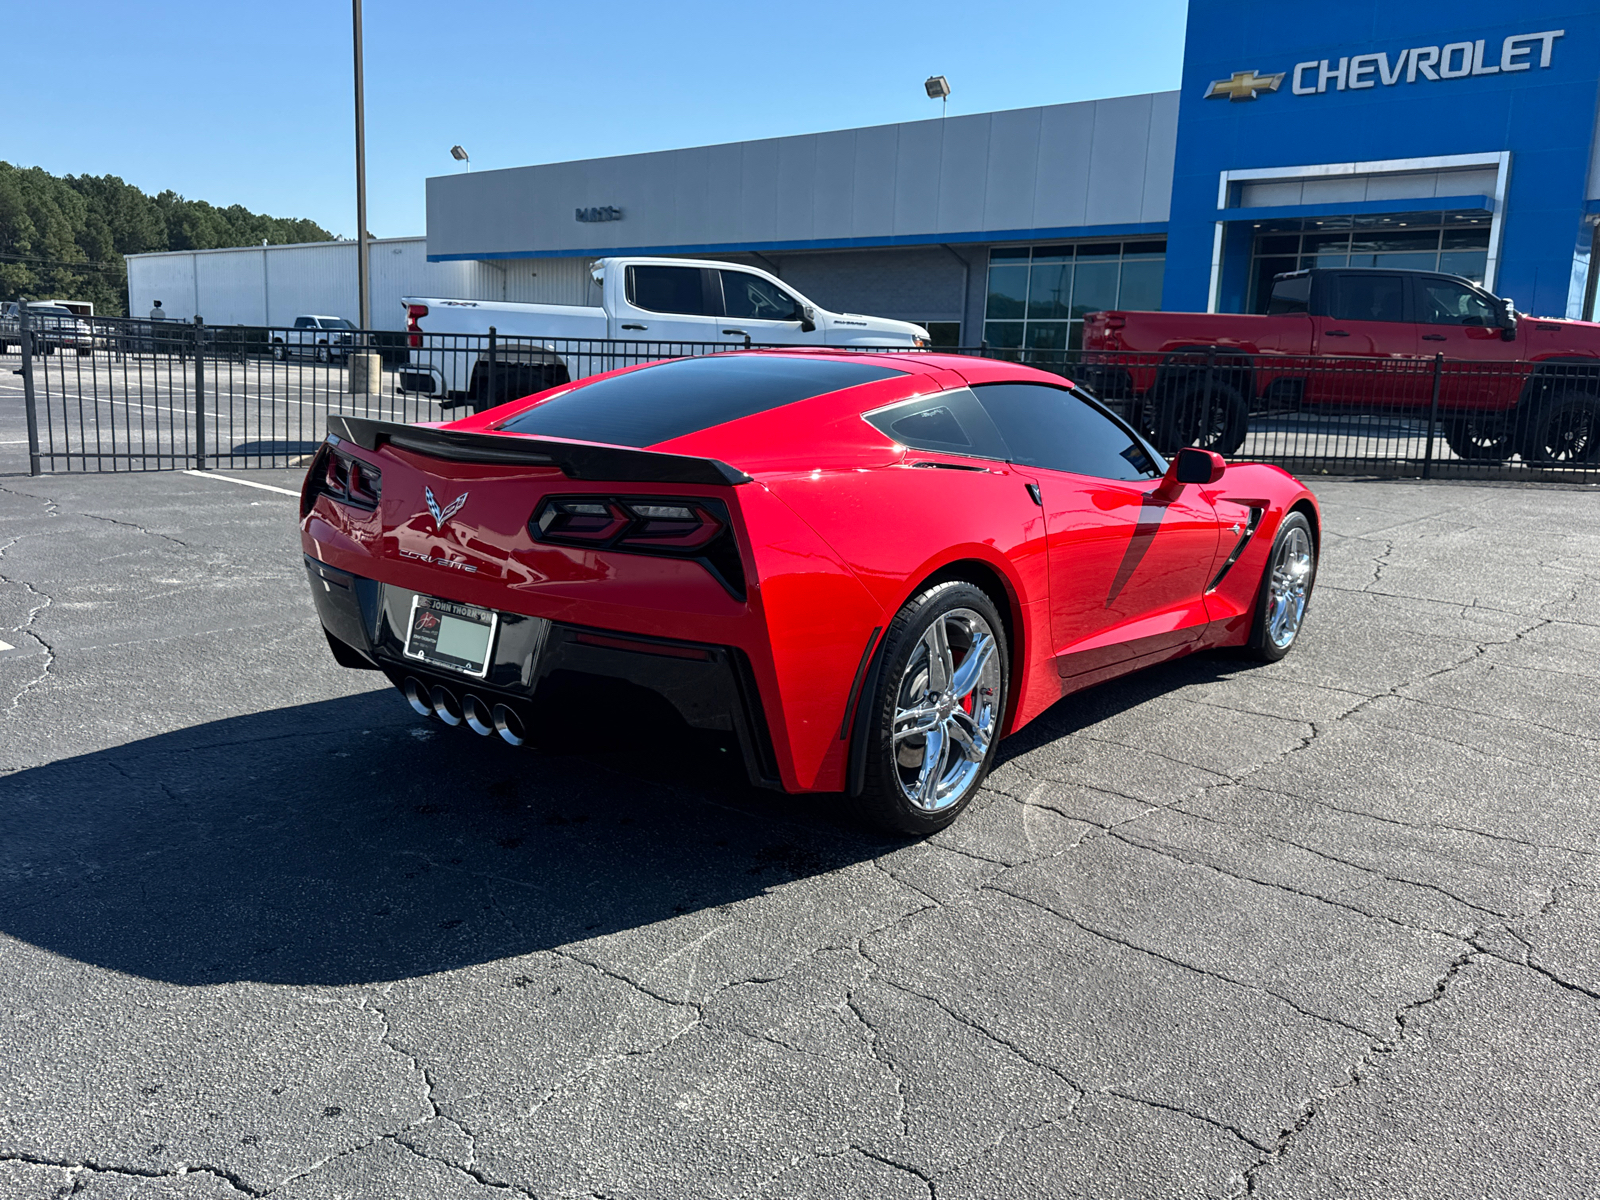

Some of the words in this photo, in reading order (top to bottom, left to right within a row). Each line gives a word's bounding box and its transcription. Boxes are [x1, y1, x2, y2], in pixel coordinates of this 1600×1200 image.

[1292, 29, 1565, 95] CHEVROLET
[399, 549, 477, 573] CORVETTE
[431, 600, 452, 612] JOHN
